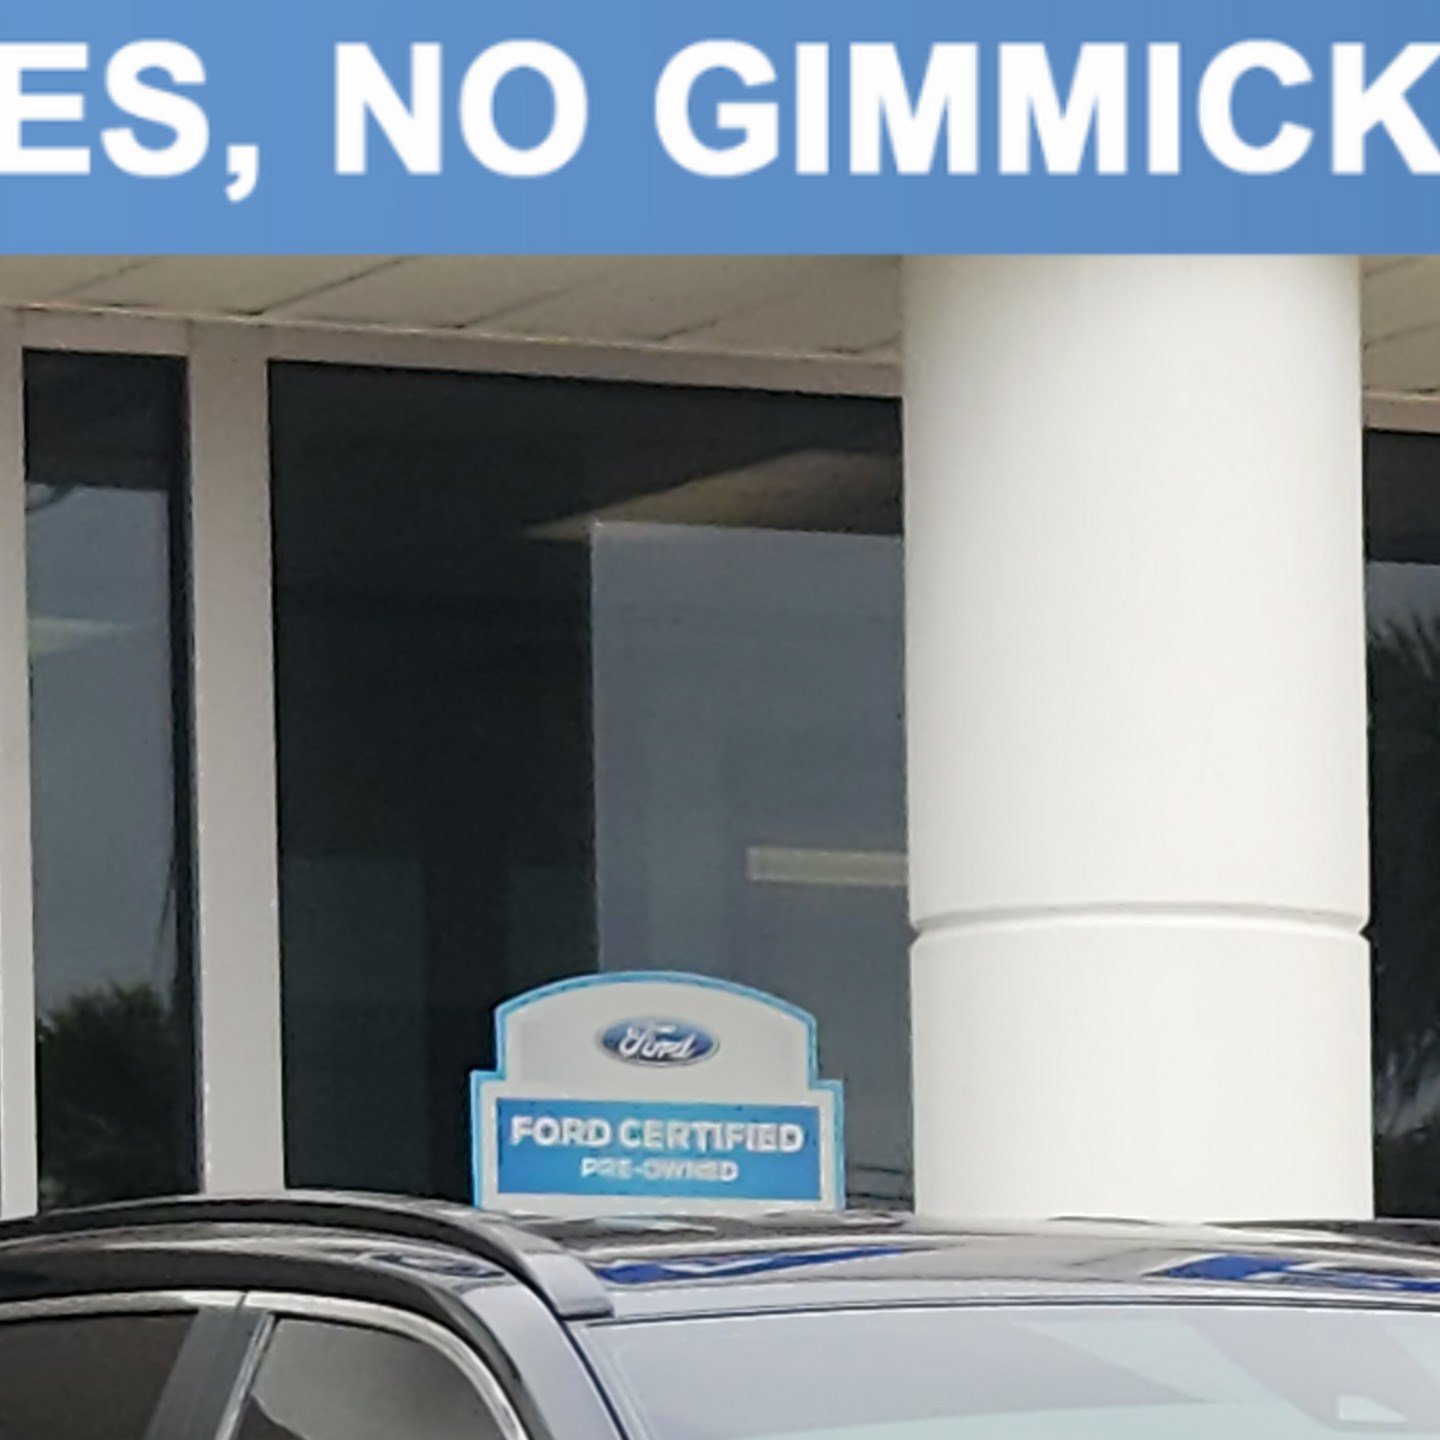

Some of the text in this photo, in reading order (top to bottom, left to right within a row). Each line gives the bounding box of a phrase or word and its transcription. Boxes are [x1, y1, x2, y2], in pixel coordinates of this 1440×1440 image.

[619, 1022, 697, 1059] Ford
[511, 1115, 805, 1153] FORD CERTIFIED
[580, 1157, 740, 1182] PRE-OWNED
